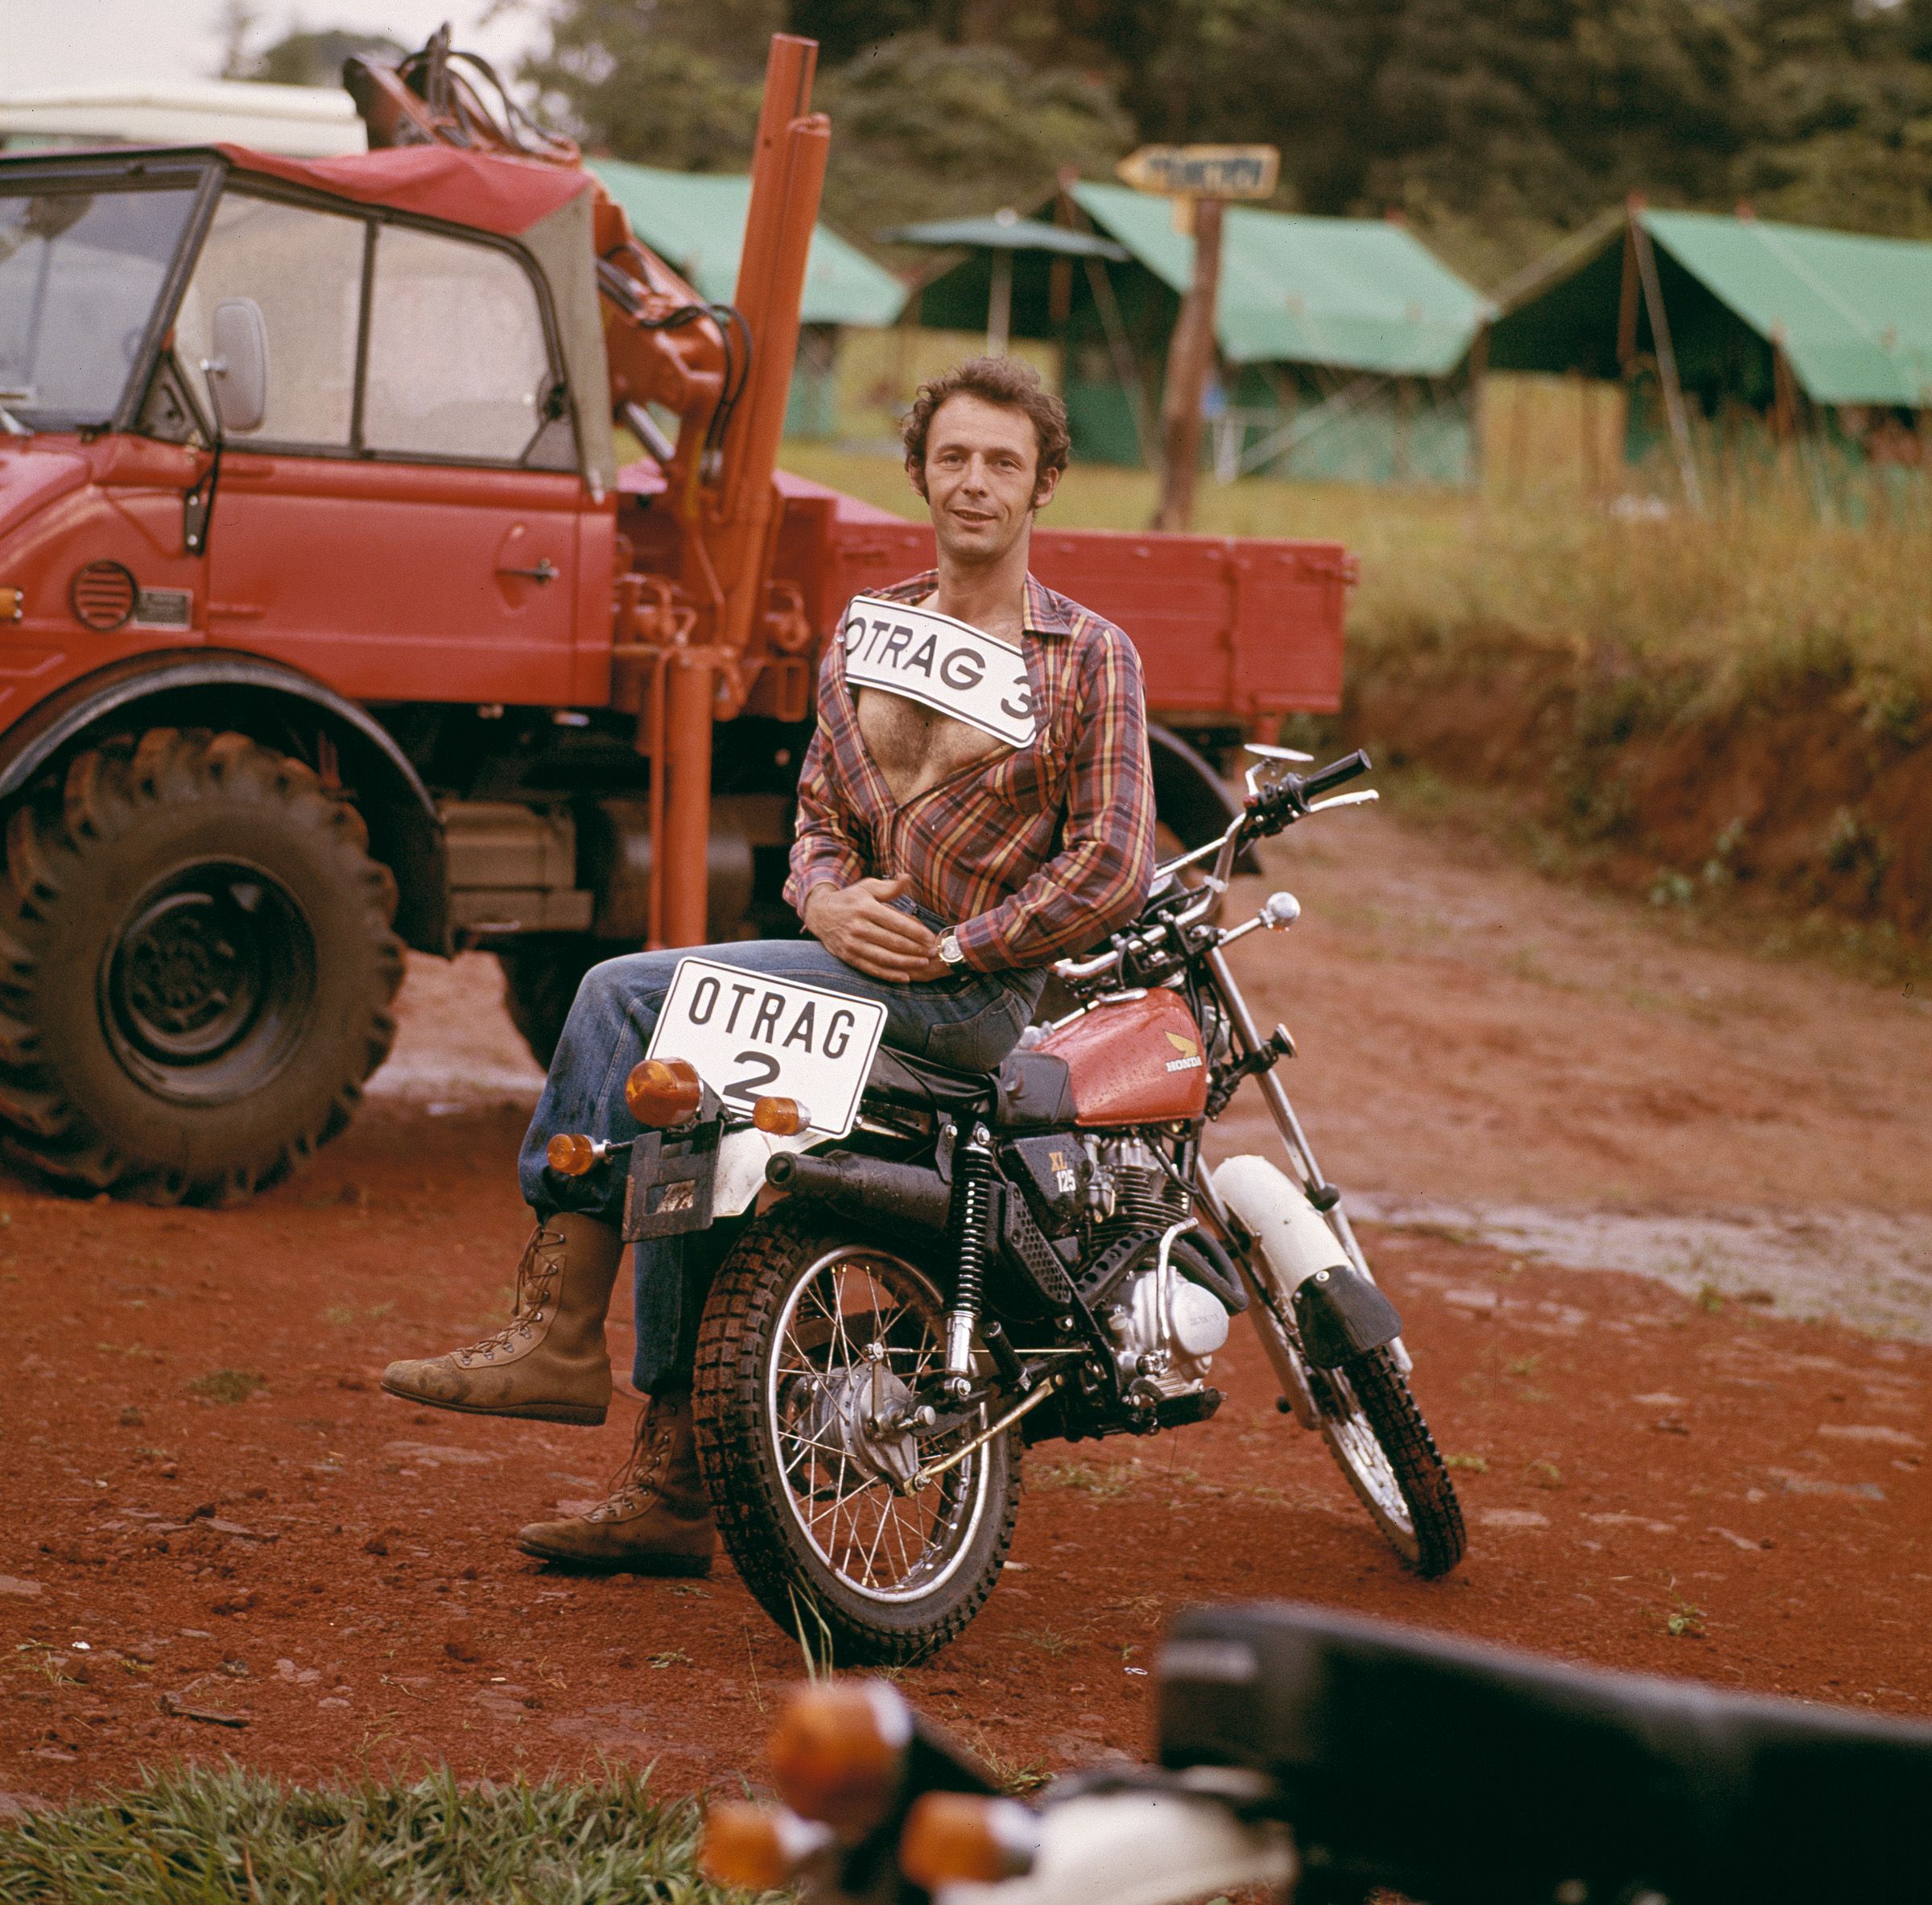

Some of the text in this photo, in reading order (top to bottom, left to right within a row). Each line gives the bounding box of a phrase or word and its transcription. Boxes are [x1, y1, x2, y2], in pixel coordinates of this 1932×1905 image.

[846, 618, 1033, 720] OTRAG 3
[688, 977, 855, 1060] OTRAG
[723, 1051, 781, 1103] 2
[1049, 1151, 1068, 1172] XL
[1056, 1169, 1076, 1192] 125
